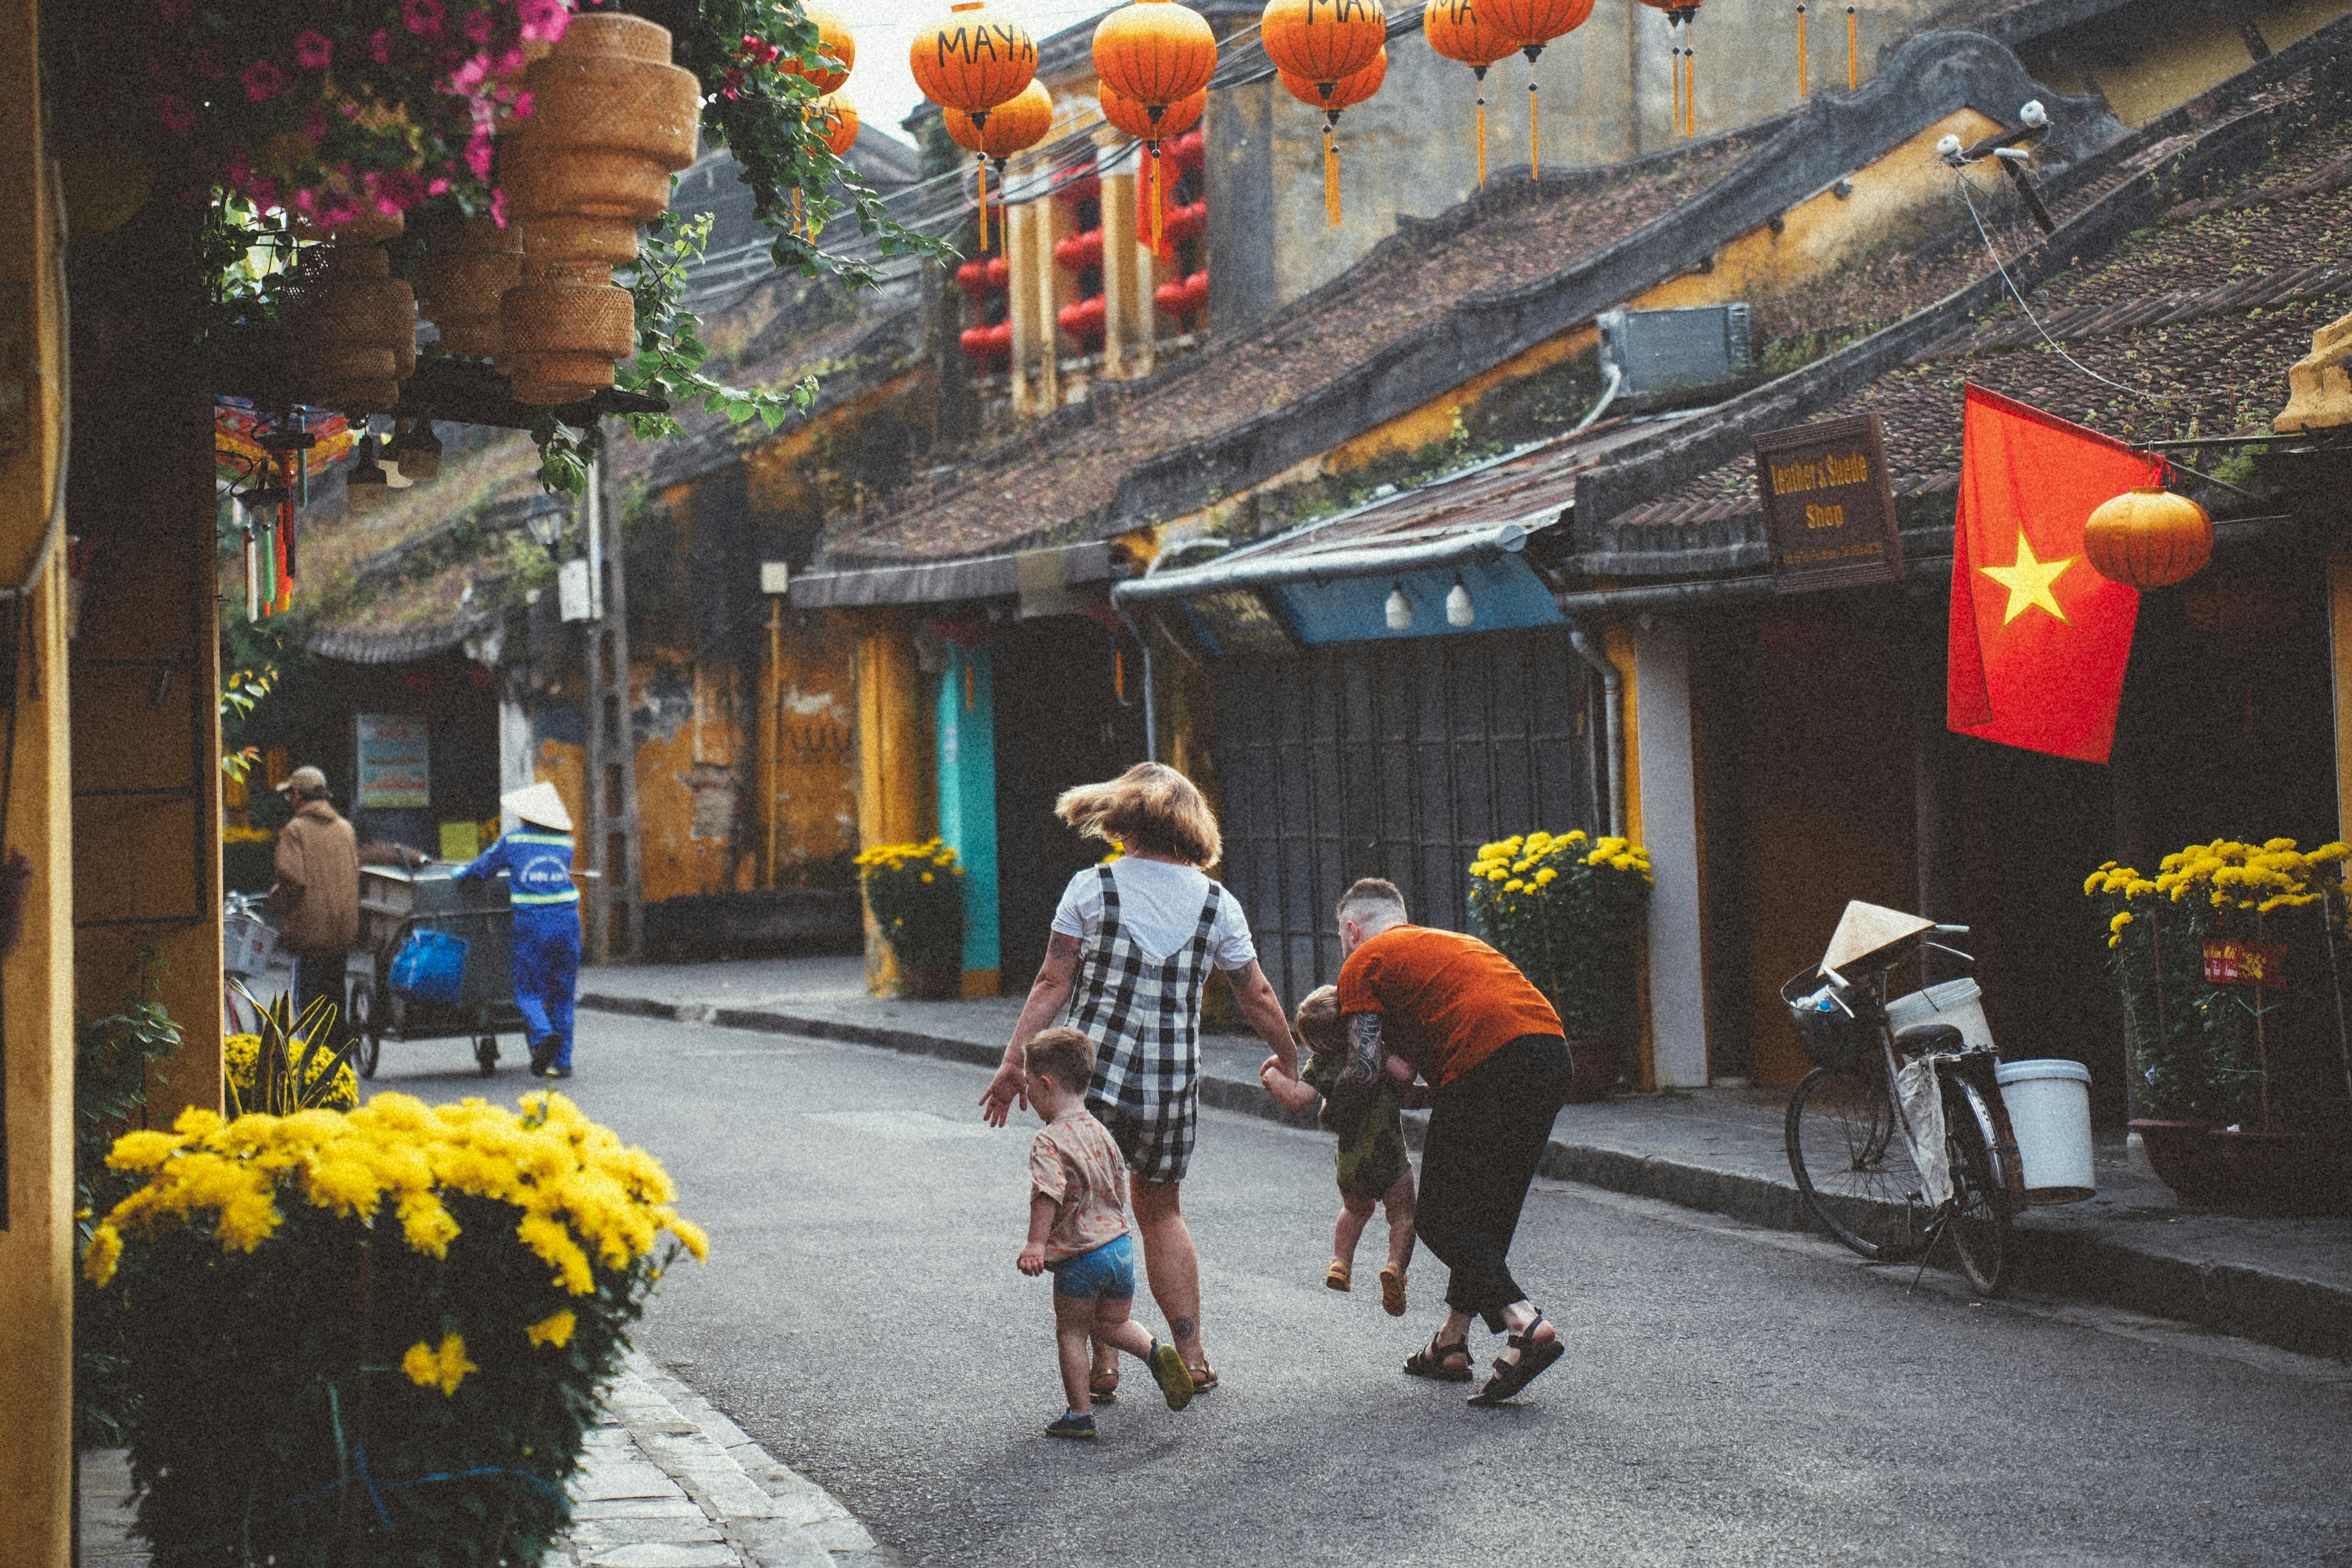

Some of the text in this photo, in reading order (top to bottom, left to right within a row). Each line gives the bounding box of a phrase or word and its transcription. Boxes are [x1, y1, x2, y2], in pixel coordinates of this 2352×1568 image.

[938, 24, 1033, 67] MAYA
[1771, 451, 1868, 495] Leather & Suede
[1805, 503, 1844, 529] Shop
